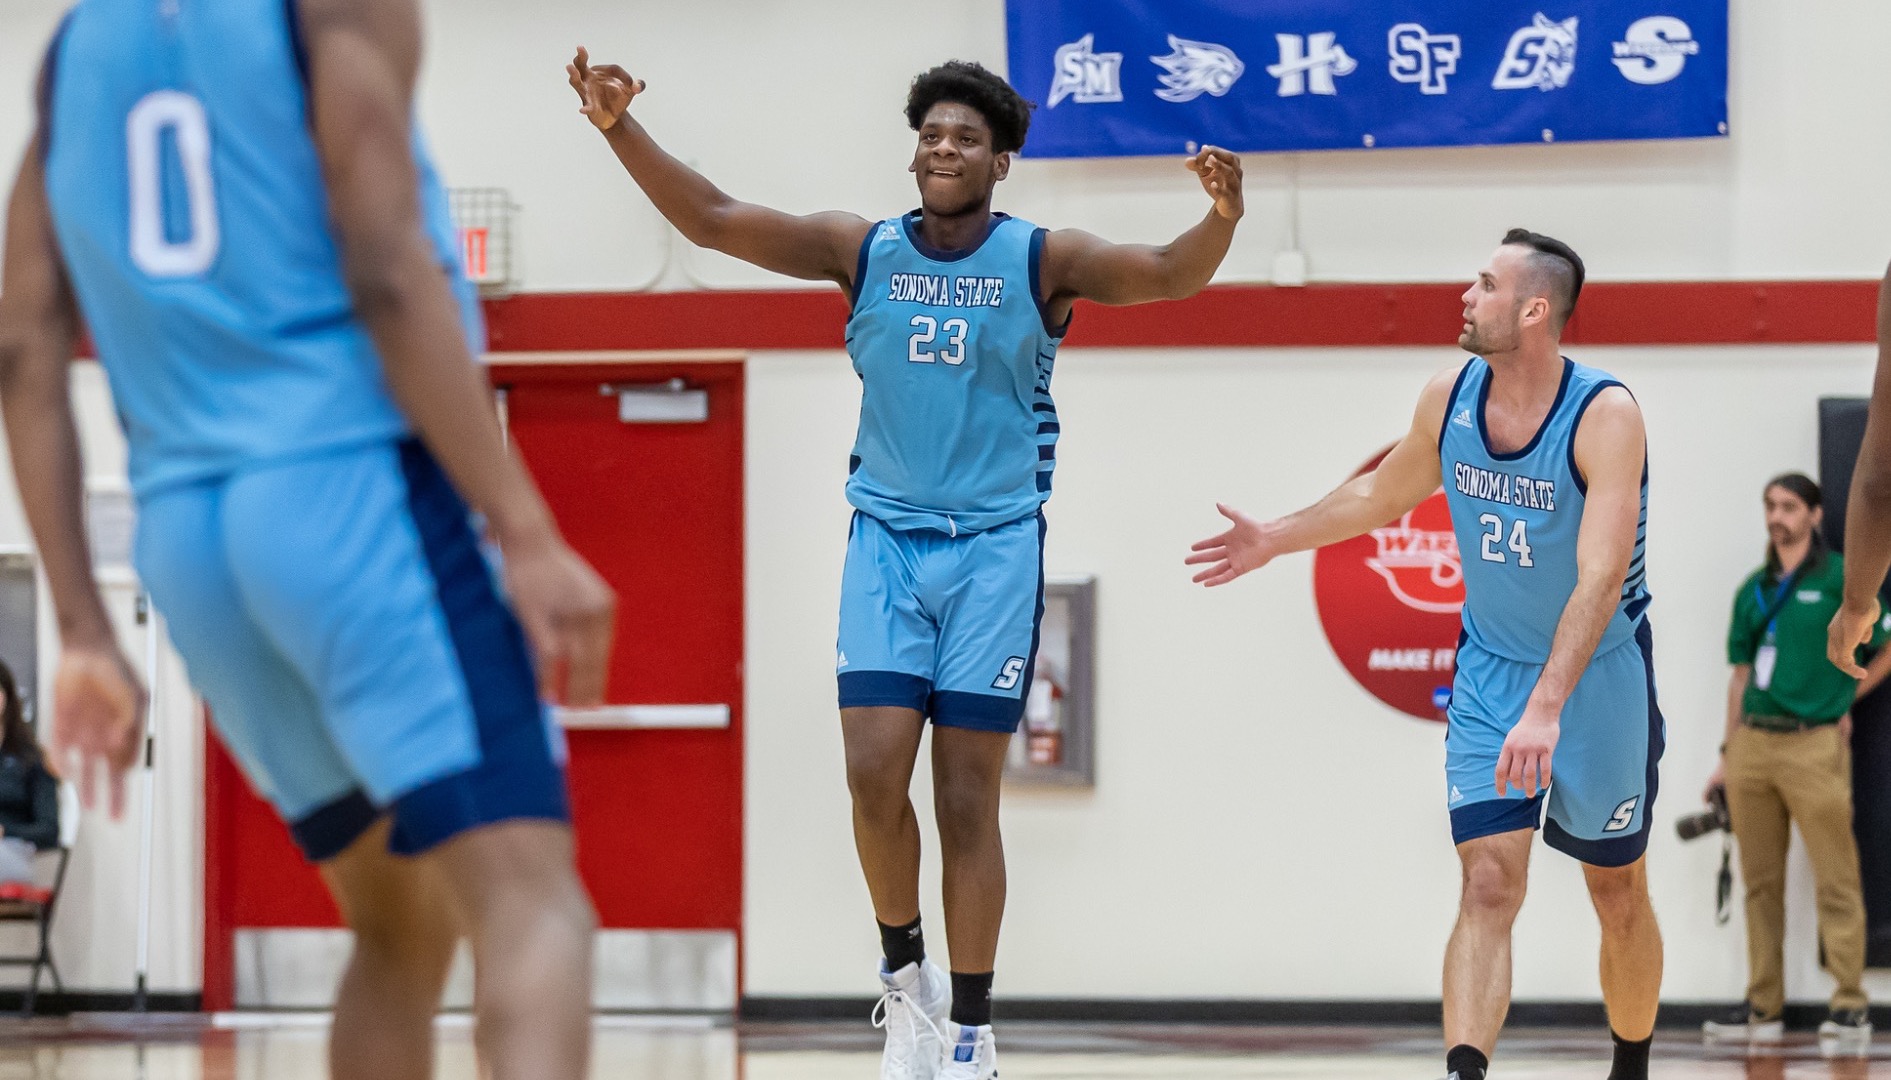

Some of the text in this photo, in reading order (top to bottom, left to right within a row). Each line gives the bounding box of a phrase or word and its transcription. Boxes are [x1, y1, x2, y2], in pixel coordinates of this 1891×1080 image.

[1388, 22, 1461, 95] SF
[126, 89, 221, 278] 0
[887, 273, 1004, 308] SONOMA STATE
[907, 314, 969, 366] 23
[1454, 461, 1556, 511] SONOMA STATE
[1479, 512, 1534, 568] 24
